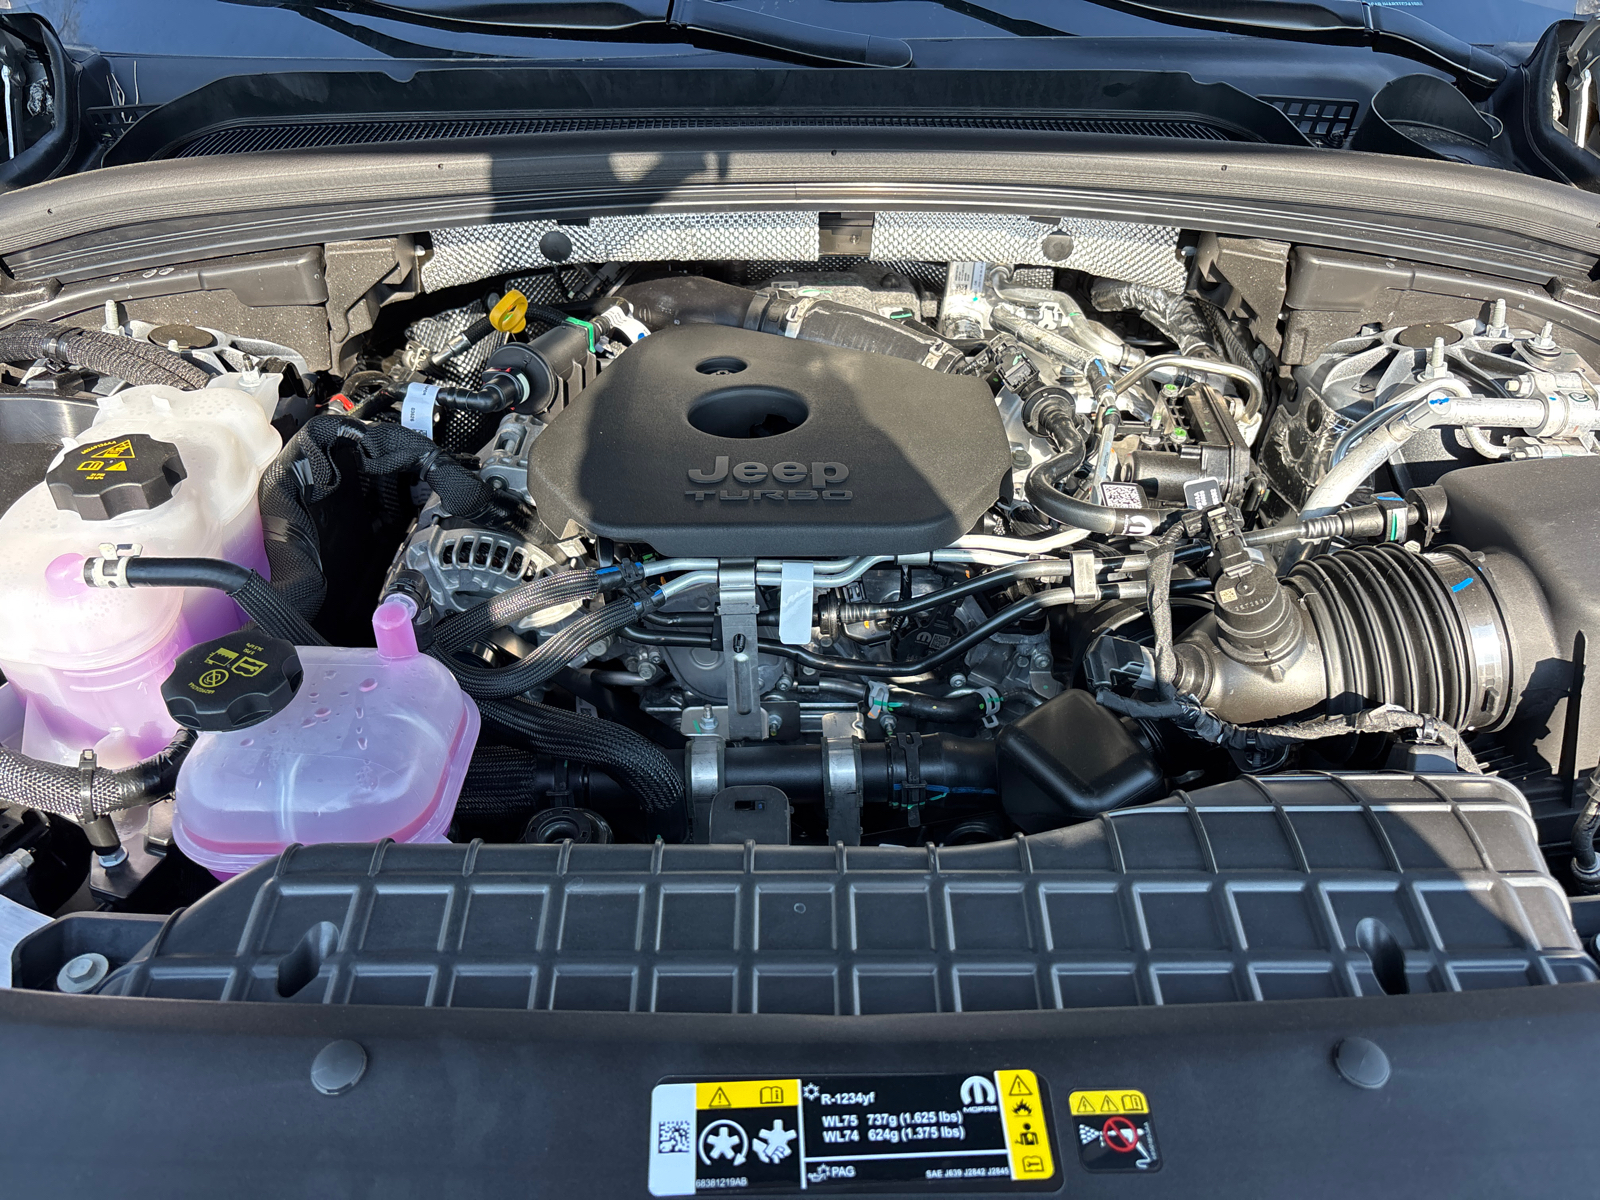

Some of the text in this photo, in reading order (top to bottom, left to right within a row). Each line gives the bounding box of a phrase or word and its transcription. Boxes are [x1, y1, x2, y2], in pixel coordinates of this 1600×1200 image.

[688, 455, 850, 489] Jeep
[684, 489, 854, 502] TURBO
[820, 1091, 876, 1106] R-1234yf
[962, 1105, 998, 1114] MOPAR
[821, 1110, 963, 1128] WL75 737g (1.625 lbs)
[822, 1126, 966, 1143] WL74 624g (1.375 lbs)
[831, 1165, 856, 1178] PAG
[925, 1166, 1009, 1179] SAE J639 J2842 J2845
[695, 1176, 748, 1189] 68381219AB
